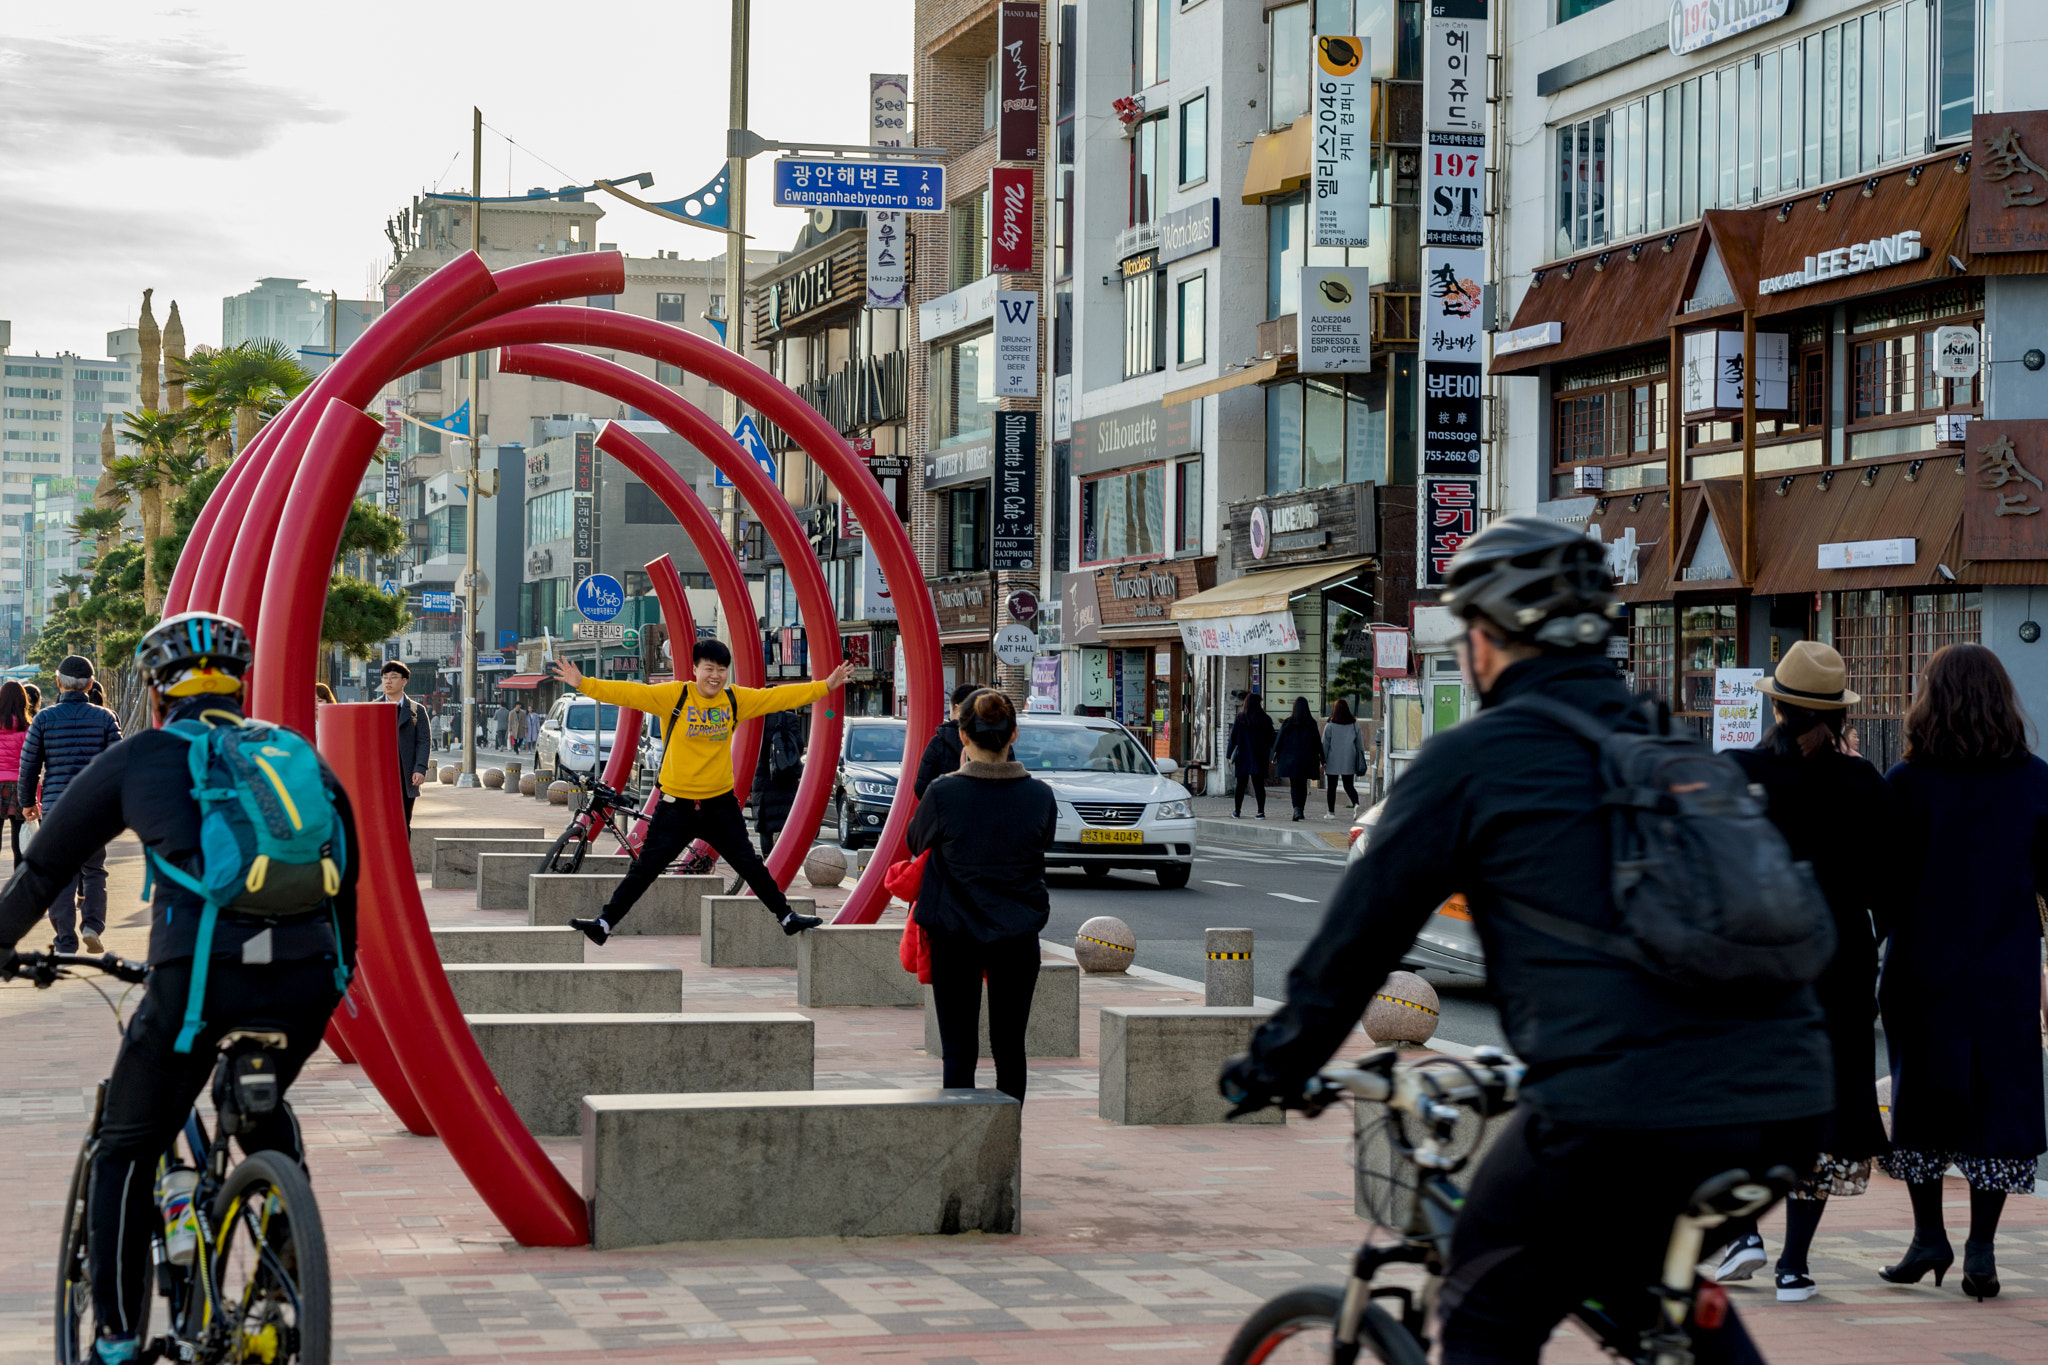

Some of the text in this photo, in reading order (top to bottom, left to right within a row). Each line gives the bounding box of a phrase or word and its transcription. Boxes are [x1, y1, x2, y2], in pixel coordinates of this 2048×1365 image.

[1432, 6, 1446, 16] 6F
[1446, 30, 1469, 127] 헤이쥬드
[875, 97, 905, 111] Sea
[1003, 98, 1037, 113] POLL
[875, 114, 904, 129] See
[1340, 83, 1355, 161] 커피 컴퍼니
[1471, 121, 1483, 130] 5F
[1317, 82, 1339, 199] 엘리스2046
[1026, 149, 1037, 157] 5F
[922, 170, 928, 180] 2
[1434, 153, 1479, 178] 197
[792, 165, 900, 189] 광안해변로
[784, 188, 908, 207] Gwanganhaebyeon-ro
[916, 196, 934, 207] 198
[1433, 185, 1478, 217] ST
[997, 183, 1025, 252] Waltz
[1163, 216, 1210, 252] Wonders
[1975, 235, 2008, 245] LEE
[1123, 256, 1151, 276] Wonders
[788, 259, 832, 316] MOTEL
[1759, 271, 1804, 295] IZAKAYA
[1000, 300, 1034, 324] W
[1943, 342, 1975, 356] Asahi
[1007, 363, 1025, 371] BEER
[1325, 361, 1333, 369] 2F
[1954, 357, 1963, 365] 生
[1010, 376, 1023, 386] 3F
[1427, 374, 1480, 398] 뷰타이
[1438, 411, 1467, 425] 按摩
[1002, 415, 1026, 467] Silhouette
[1098, 413, 1157, 454] Silhouette
[1428, 431, 1477, 442] massage
[966, 446, 987, 472] BURGER
[1426, 451, 1466, 461] 755-2662
[877, 468, 902, 476] BURGER
[386, 462, 400, 504] 노래방
[1003, 496, 1025, 520] Cafe
[578, 499, 589, 550] 노래연습장
[1272, 503, 1319, 533] ALICE2046
[1113, 571, 1177, 599] Thursday Party
[614, 657, 638, 671] BAR
[1113, 831, 1139, 842] 4049
